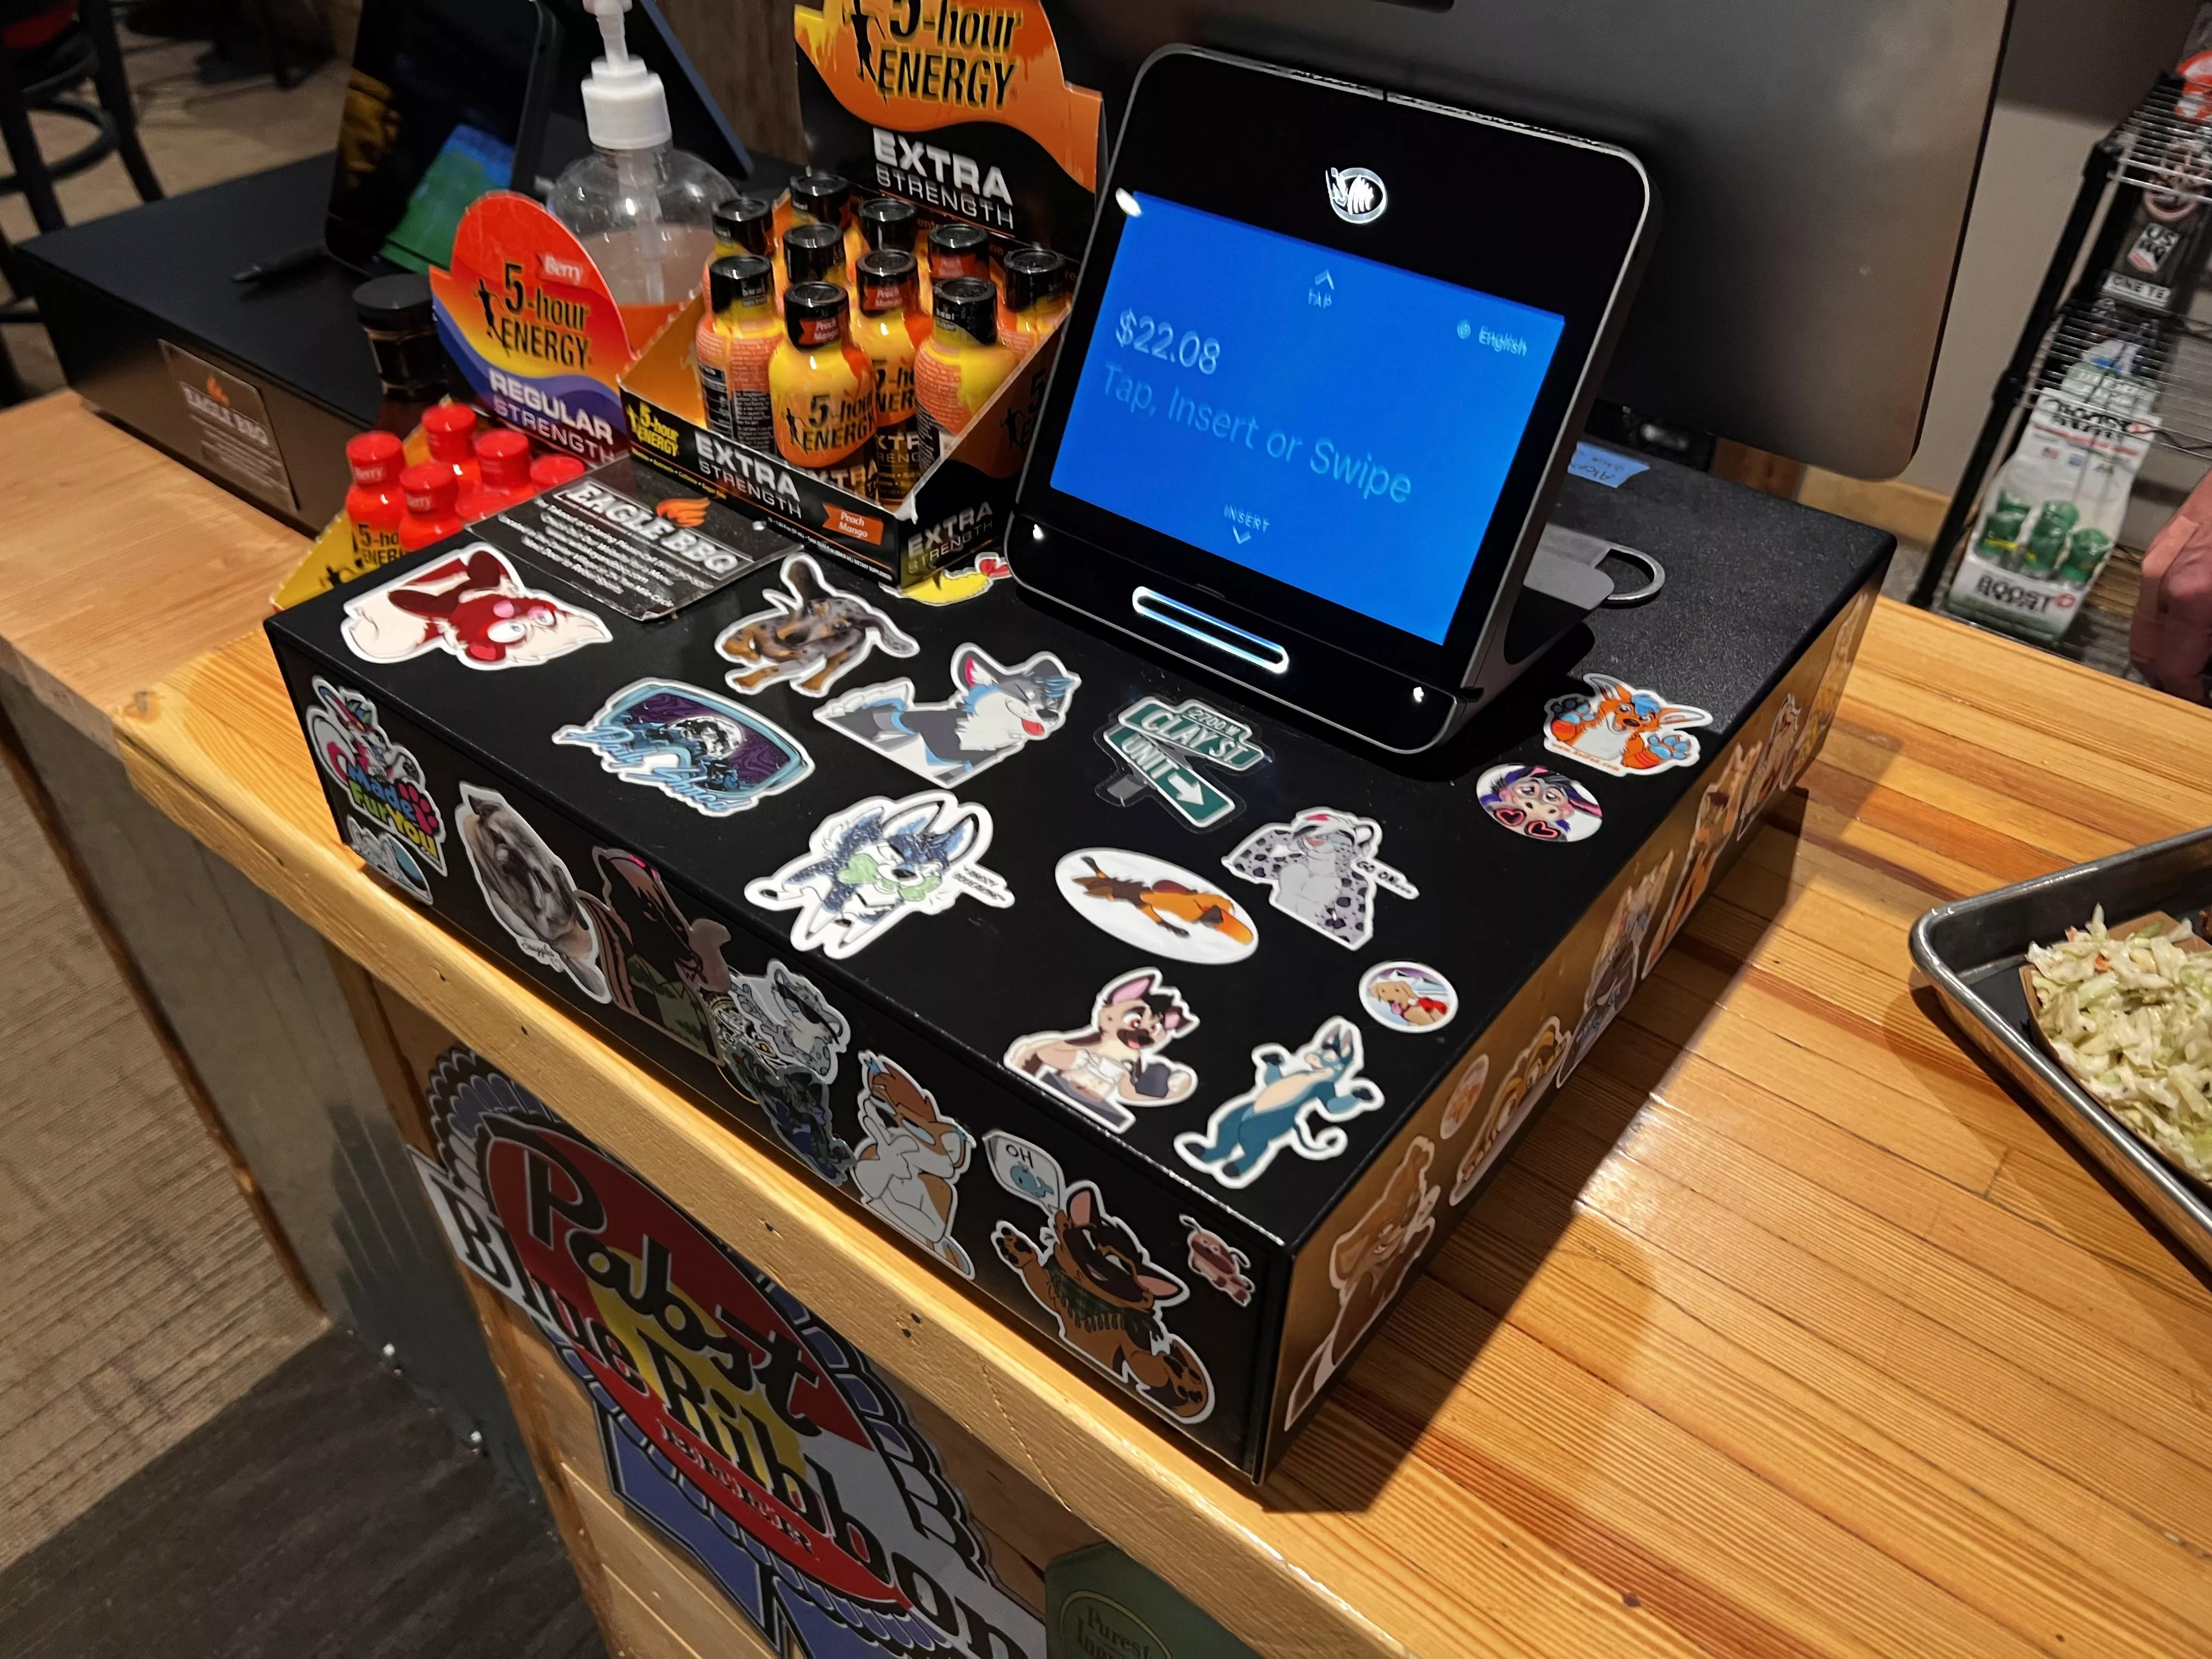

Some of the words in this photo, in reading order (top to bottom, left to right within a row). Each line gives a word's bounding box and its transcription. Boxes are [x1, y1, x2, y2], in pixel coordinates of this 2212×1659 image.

[879, 48, 1018, 109] ENERGY
[872, 127, 1013, 206] EXTRA
[876, 163, 1014, 230] STRENGTH
[504, 262, 590, 330] 5-hour
[500, 318, 589, 370] ENERGY
[1115, 308, 1220, 375] $22.08
[1479, 326, 1527, 357] English
[489, 368, 613, 445] REGULAR
[494, 396, 614, 462] STRENGTH
[640, 401, 679, 441] 5-hour
[1103, 361, 1156, 417] Tap,
[1168, 387, 1257, 450] Insert
[1266, 430, 1303, 462] or
[1309, 439, 1412, 503] Swipe
[638, 427, 679, 457] ENERGY
[693, 431, 801, 504] EXTRA
[698, 459, 803, 520] STRENGTH
[566, 484, 674, 539] EAGLE
[661, 528, 739, 573] BBQ
[839, 521, 868, 539] Mango
[840, 511, 865, 527] Peach
[907, 501, 993, 557] EXTRA
[908, 518, 993, 574] STRENGTH
[1224, 504, 1269, 532] INSERT
[648, 569, 675, 586] Menu
[1141, 710, 1218, 747] CLAY
[1188, 707, 1228, 731] 2700
[1121, 733, 1180, 779] UNIT
[346, 762, 417, 822] Made
[1356, 860, 1375, 873] GO
[1005, 1144, 1037, 1170] OH
[429, 1171, 653, 1398] Blue
[477, 1111, 824, 1437] Pabst
